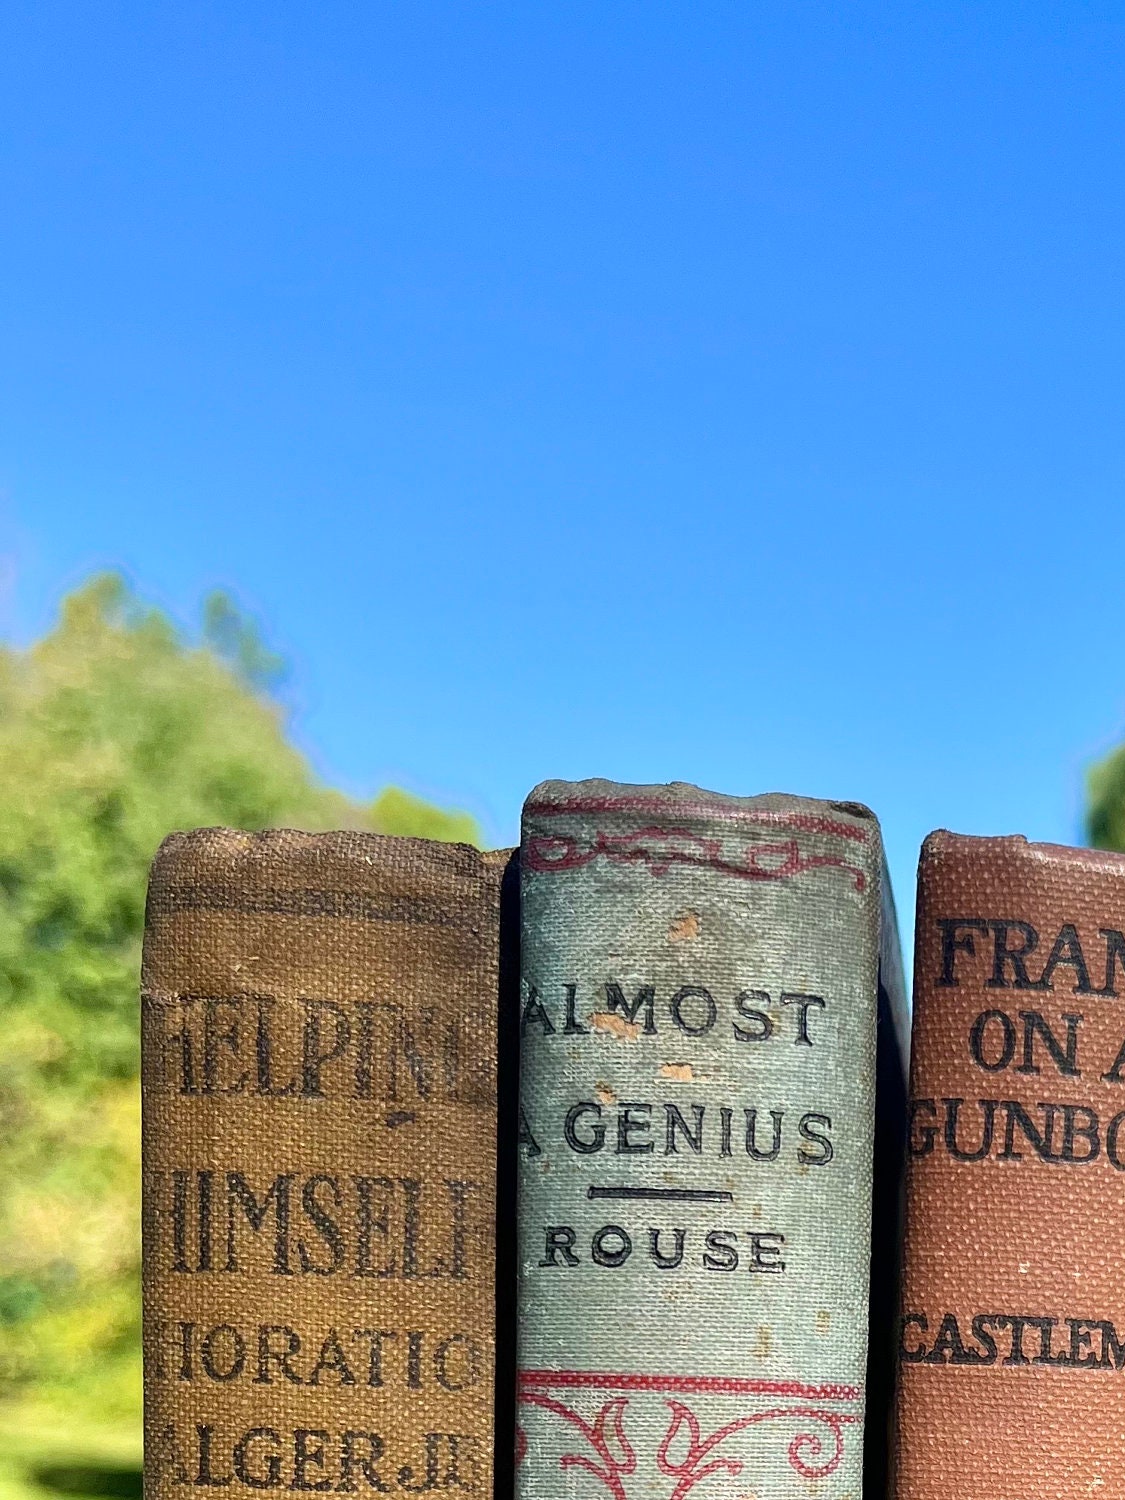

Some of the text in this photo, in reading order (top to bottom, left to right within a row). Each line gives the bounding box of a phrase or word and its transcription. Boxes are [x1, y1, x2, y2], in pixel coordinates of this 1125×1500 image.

[520, 983, 826, 1046] ALMOST
[968, 1009, 1084, 1078] ON
[564, 1101, 834, 1166] GENIUS
[538, 1225, 786, 1273] ROUSE
